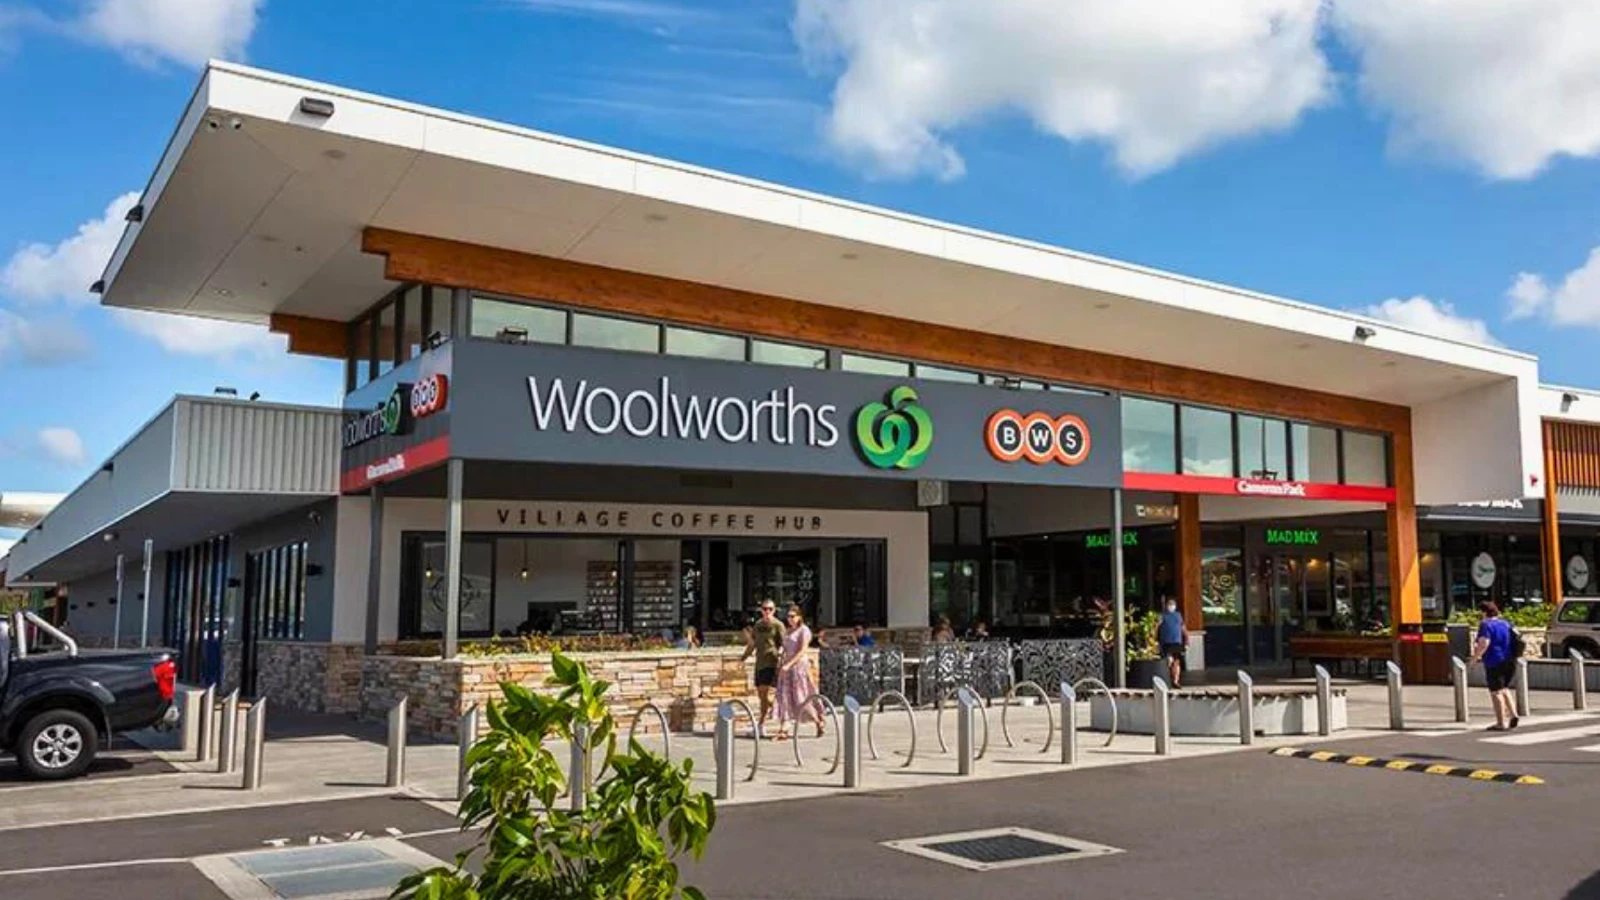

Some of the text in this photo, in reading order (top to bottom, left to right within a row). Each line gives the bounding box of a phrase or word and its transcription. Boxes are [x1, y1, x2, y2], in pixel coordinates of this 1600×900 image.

[528, 376, 840, 448] Woolworths
[497, 509, 629, 527] VILLAGE
[775, 515, 822, 531] HUB
[1267, 529, 1294, 545] MAD
